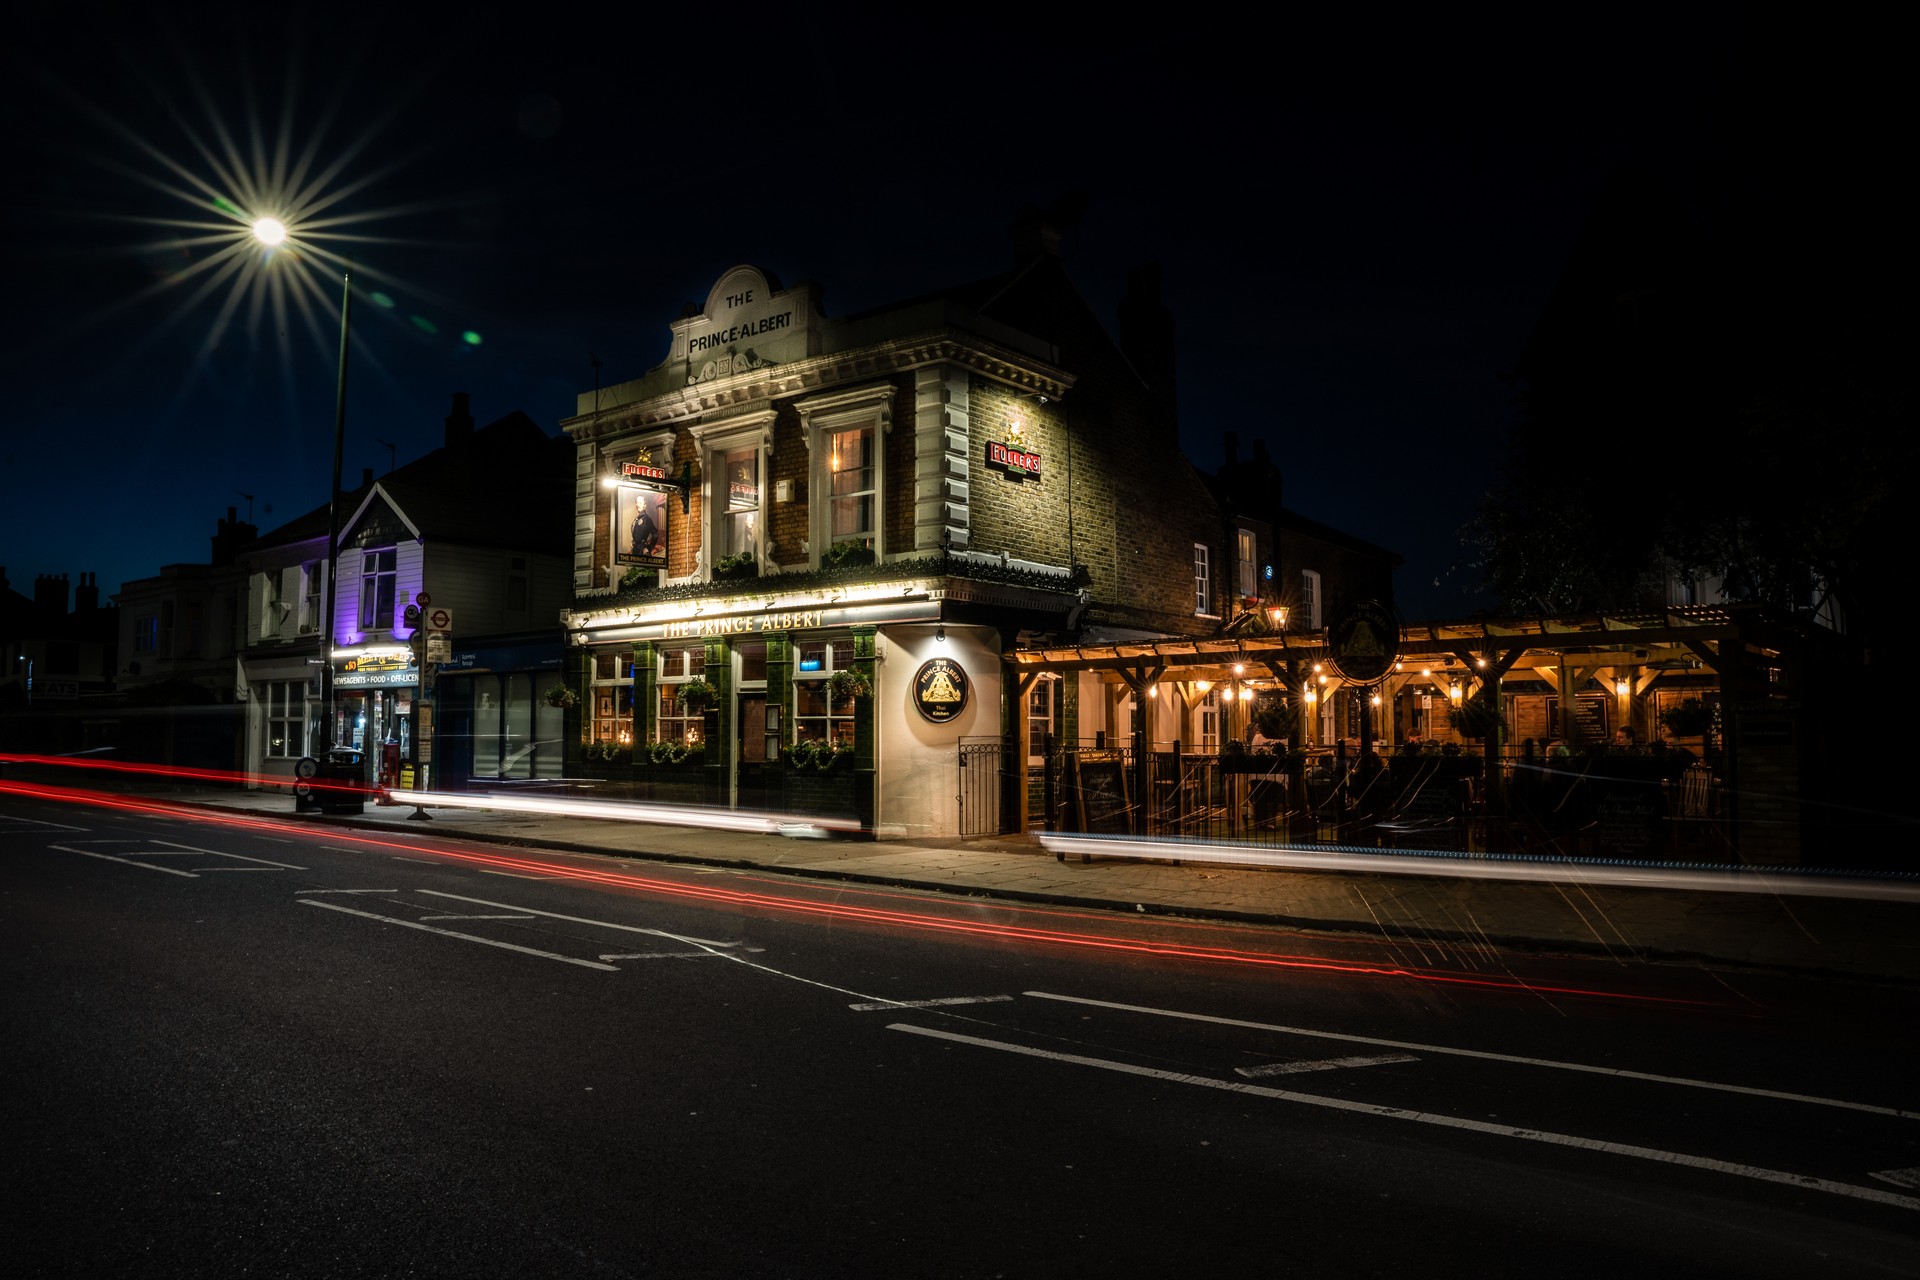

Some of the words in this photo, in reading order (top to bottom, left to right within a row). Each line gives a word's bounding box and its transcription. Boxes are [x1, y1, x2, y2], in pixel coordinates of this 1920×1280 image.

[726, 290, 753, 308] THE
[689, 312, 791, 353] PRINCE-ALBERT
[662, 623, 689, 637] THE
[697, 616, 753, 635] PRINCE
[761, 611, 823, 630] ALBERT
[333, 675, 366, 686] NEWSAGENTS
[370, 675, 386, 684] FOOD
[390, 673, 418, 685] OFF-LICEN
[921, 666, 941, 683] PRINCE
[942, 666, 961, 683] ALBERT
